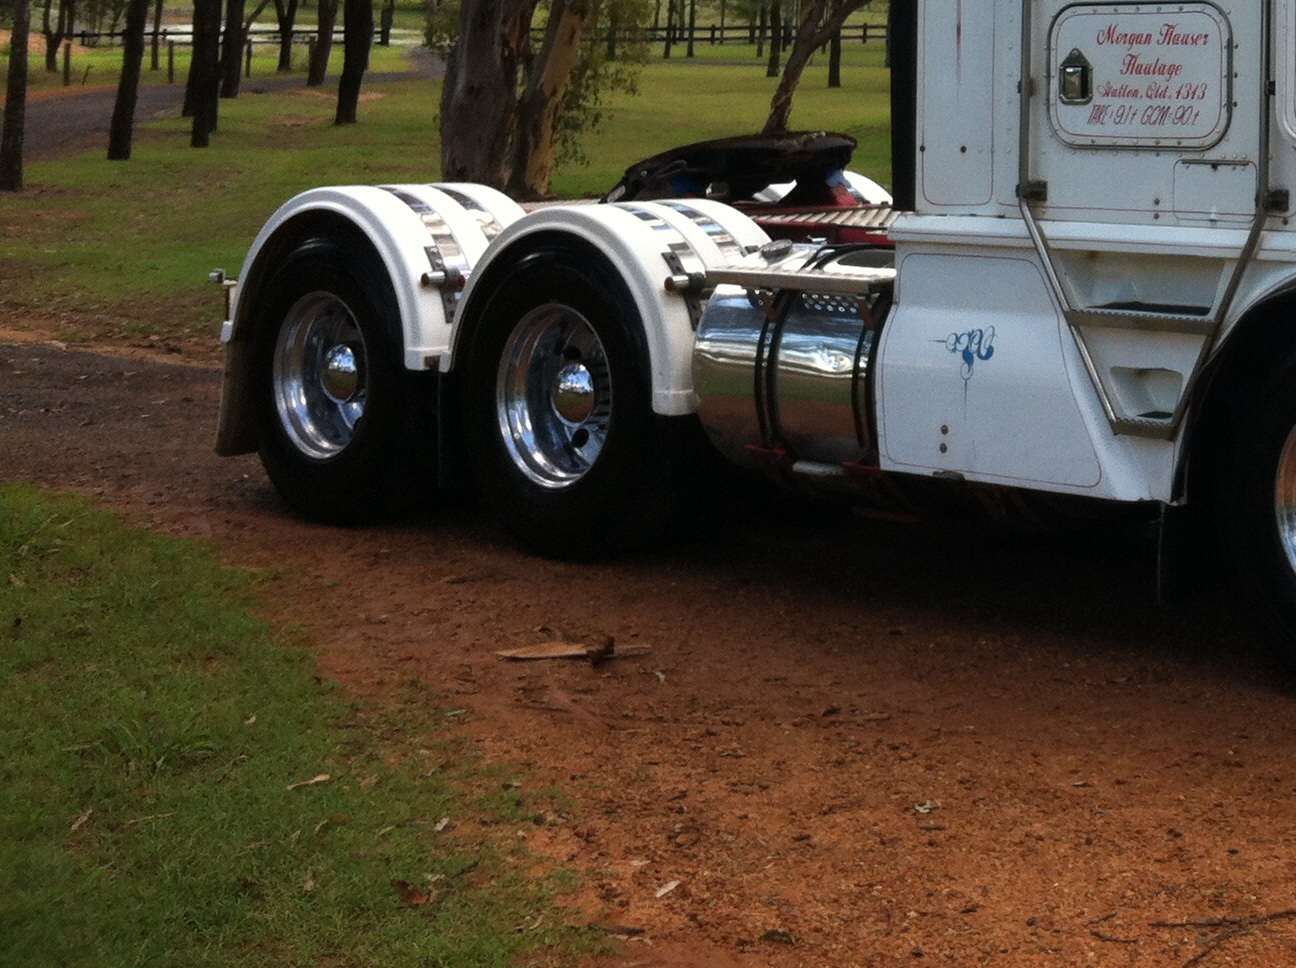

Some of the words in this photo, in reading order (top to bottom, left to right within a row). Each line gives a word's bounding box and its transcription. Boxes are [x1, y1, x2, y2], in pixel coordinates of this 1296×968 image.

[1096, 23, 1153, 51] Morgan
[1156, 22, 1210, 46] Hauser
[1120, 53, 1183, 82] Haulage
